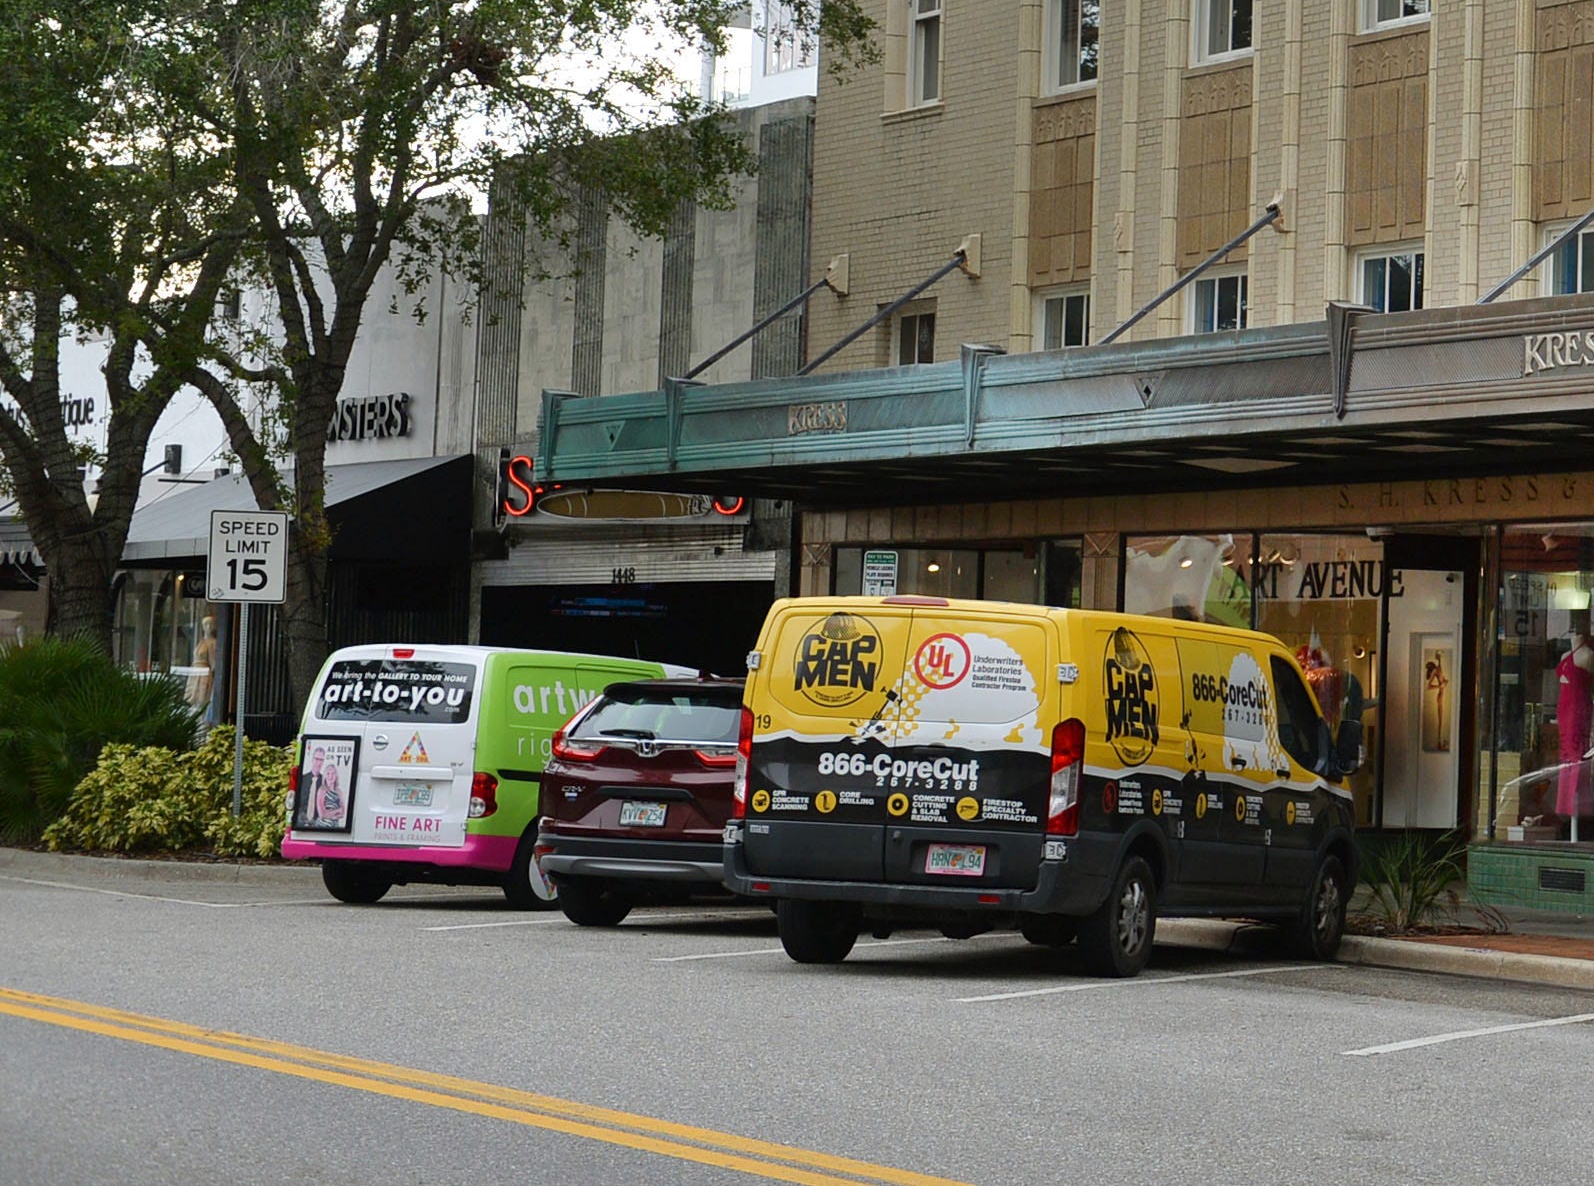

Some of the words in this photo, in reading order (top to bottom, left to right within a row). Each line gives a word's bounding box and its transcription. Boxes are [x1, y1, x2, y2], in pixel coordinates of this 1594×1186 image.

[788, 401, 847, 436] KRESS
[1422, 478, 1540, 506] KRESS
[219, 521, 279, 536] SPEED
[225, 539, 271, 554] LIMIT
[226, 558, 268, 591] 15
[611, 567, 636, 584] 1448
[1296, 559, 1405, 599] AVENUE
[802, 634, 877, 664] CAP
[928, 645, 955, 677] UL
[974, 655, 1023, 666] Underwriters
[378, 672, 408, 680] GALLERY
[422, 673, 442, 681] YOUR
[444, 675, 467, 683] HOME
[794, 660, 877, 692] MEN
[972, 664, 1022, 675] Laboratories
[1106, 658, 1154, 700] CAP
[324, 681, 465, 711] art-to-you
[1192, 673, 1268, 710] 866-CoreCut
[755, 715, 771, 729] 19
[1105, 698, 1160, 746] MEN
[336, 754, 351, 766] TV
[818, 752, 980, 781] 866-CoreCut
[912, 795, 955, 803] CONCRETE
[912, 801, 947, 809] CUTTING
[982, 798, 1023, 808] FIRESTOP
[981, 813, 1038, 823] CONTRACTOR
[982, 806, 1027, 814] SPECIALTY
[375, 816, 406, 831] FINE
[412, 818, 443, 832] ART
[911, 815, 948, 823] REMOVAL
